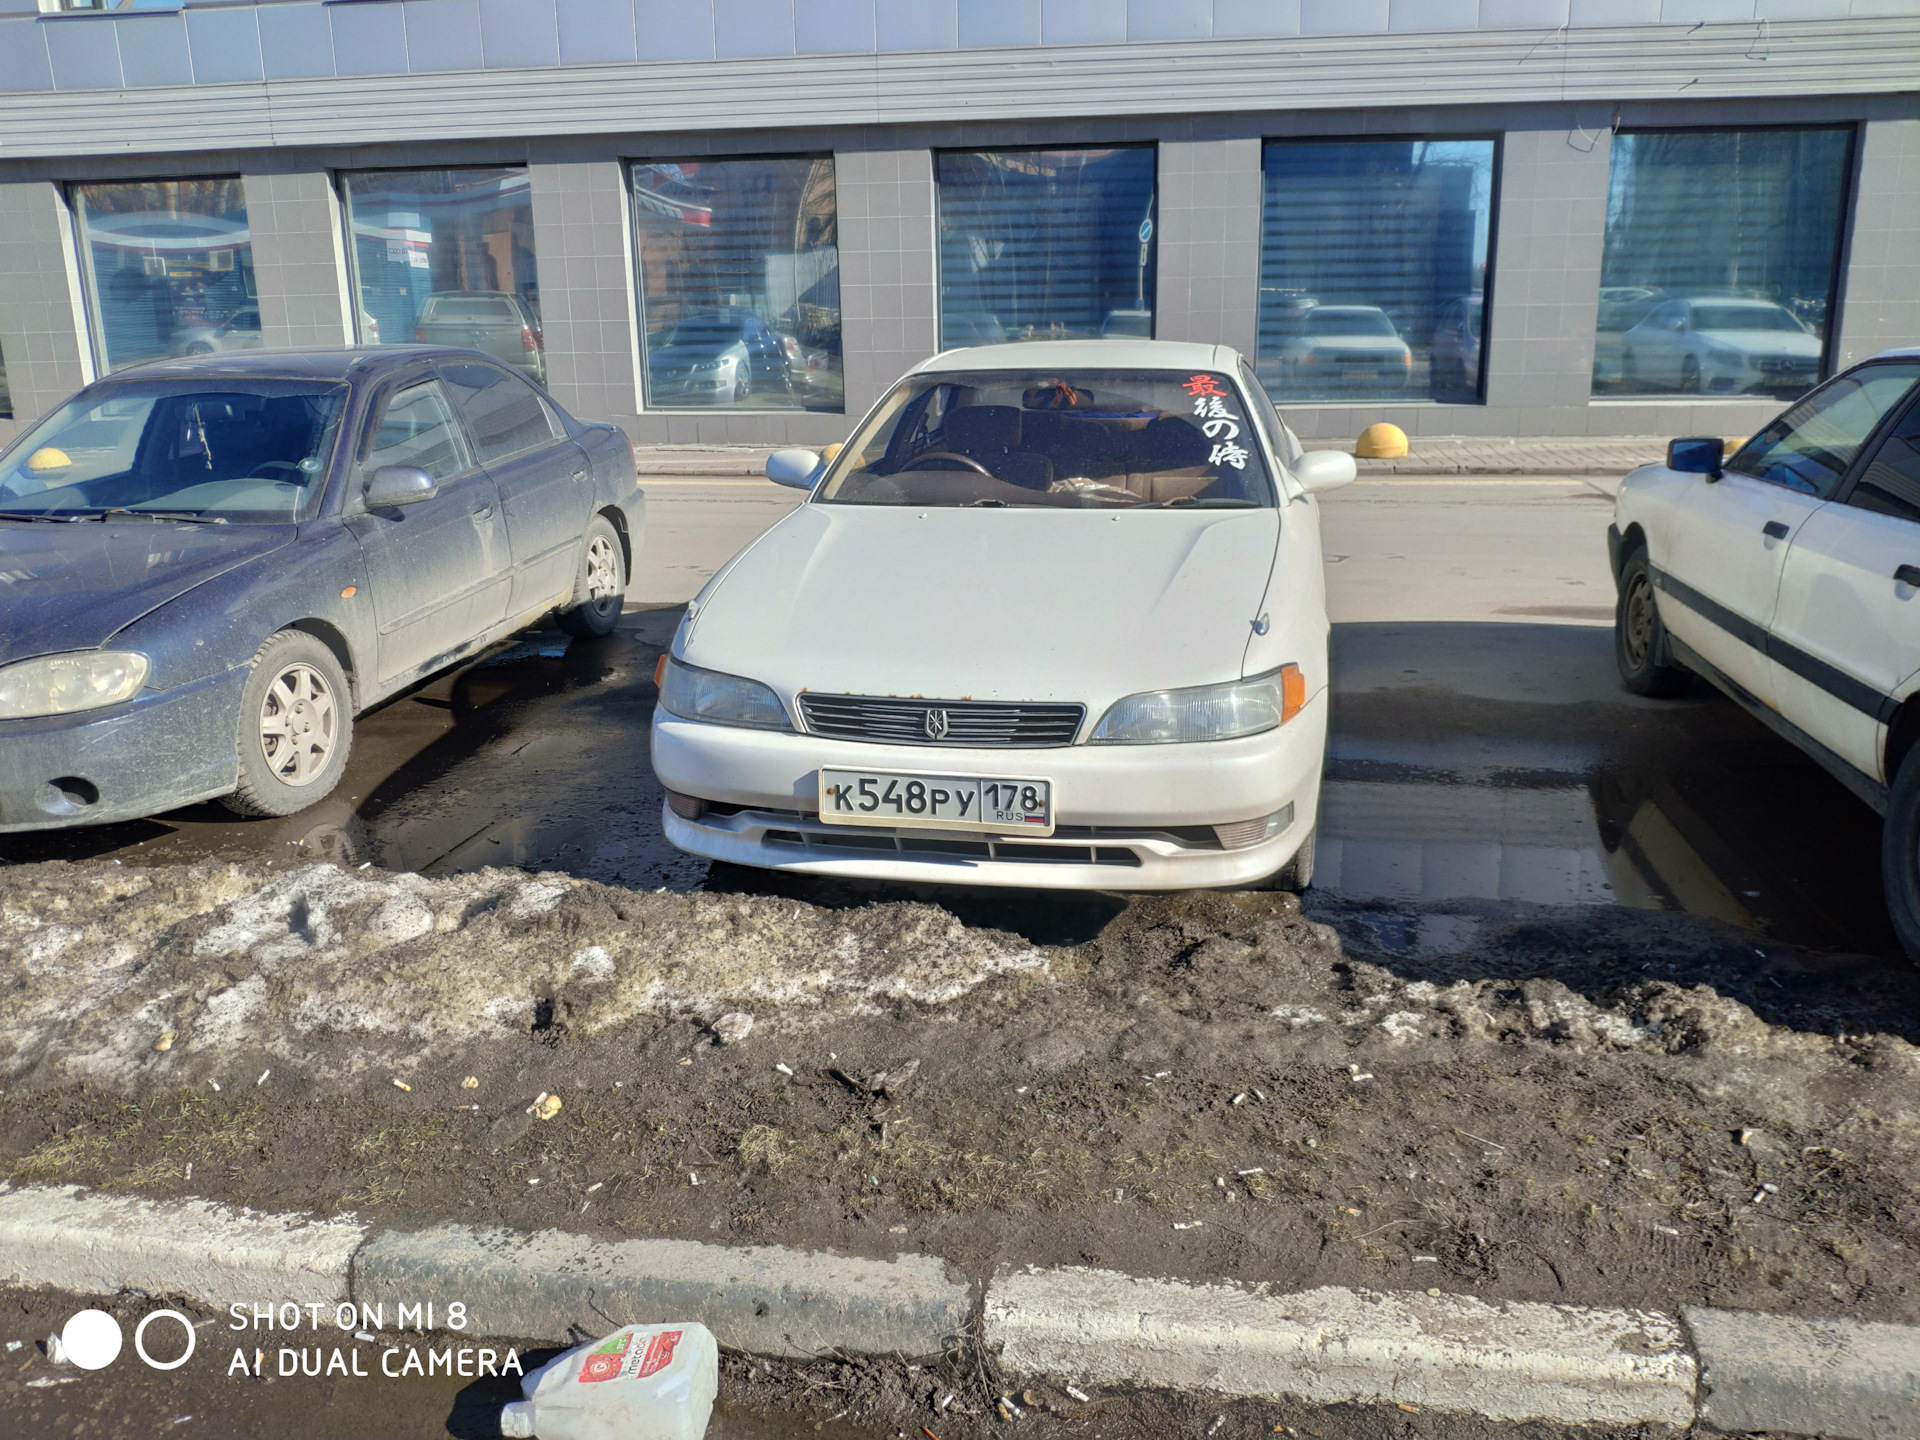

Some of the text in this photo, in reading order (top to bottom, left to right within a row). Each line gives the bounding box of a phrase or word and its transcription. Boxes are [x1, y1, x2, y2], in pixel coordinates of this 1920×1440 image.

[1182, 374, 1248, 470] 最後の侍
[984, 783, 1039, 812] 178
[996, 810, 1024, 822] RUS
